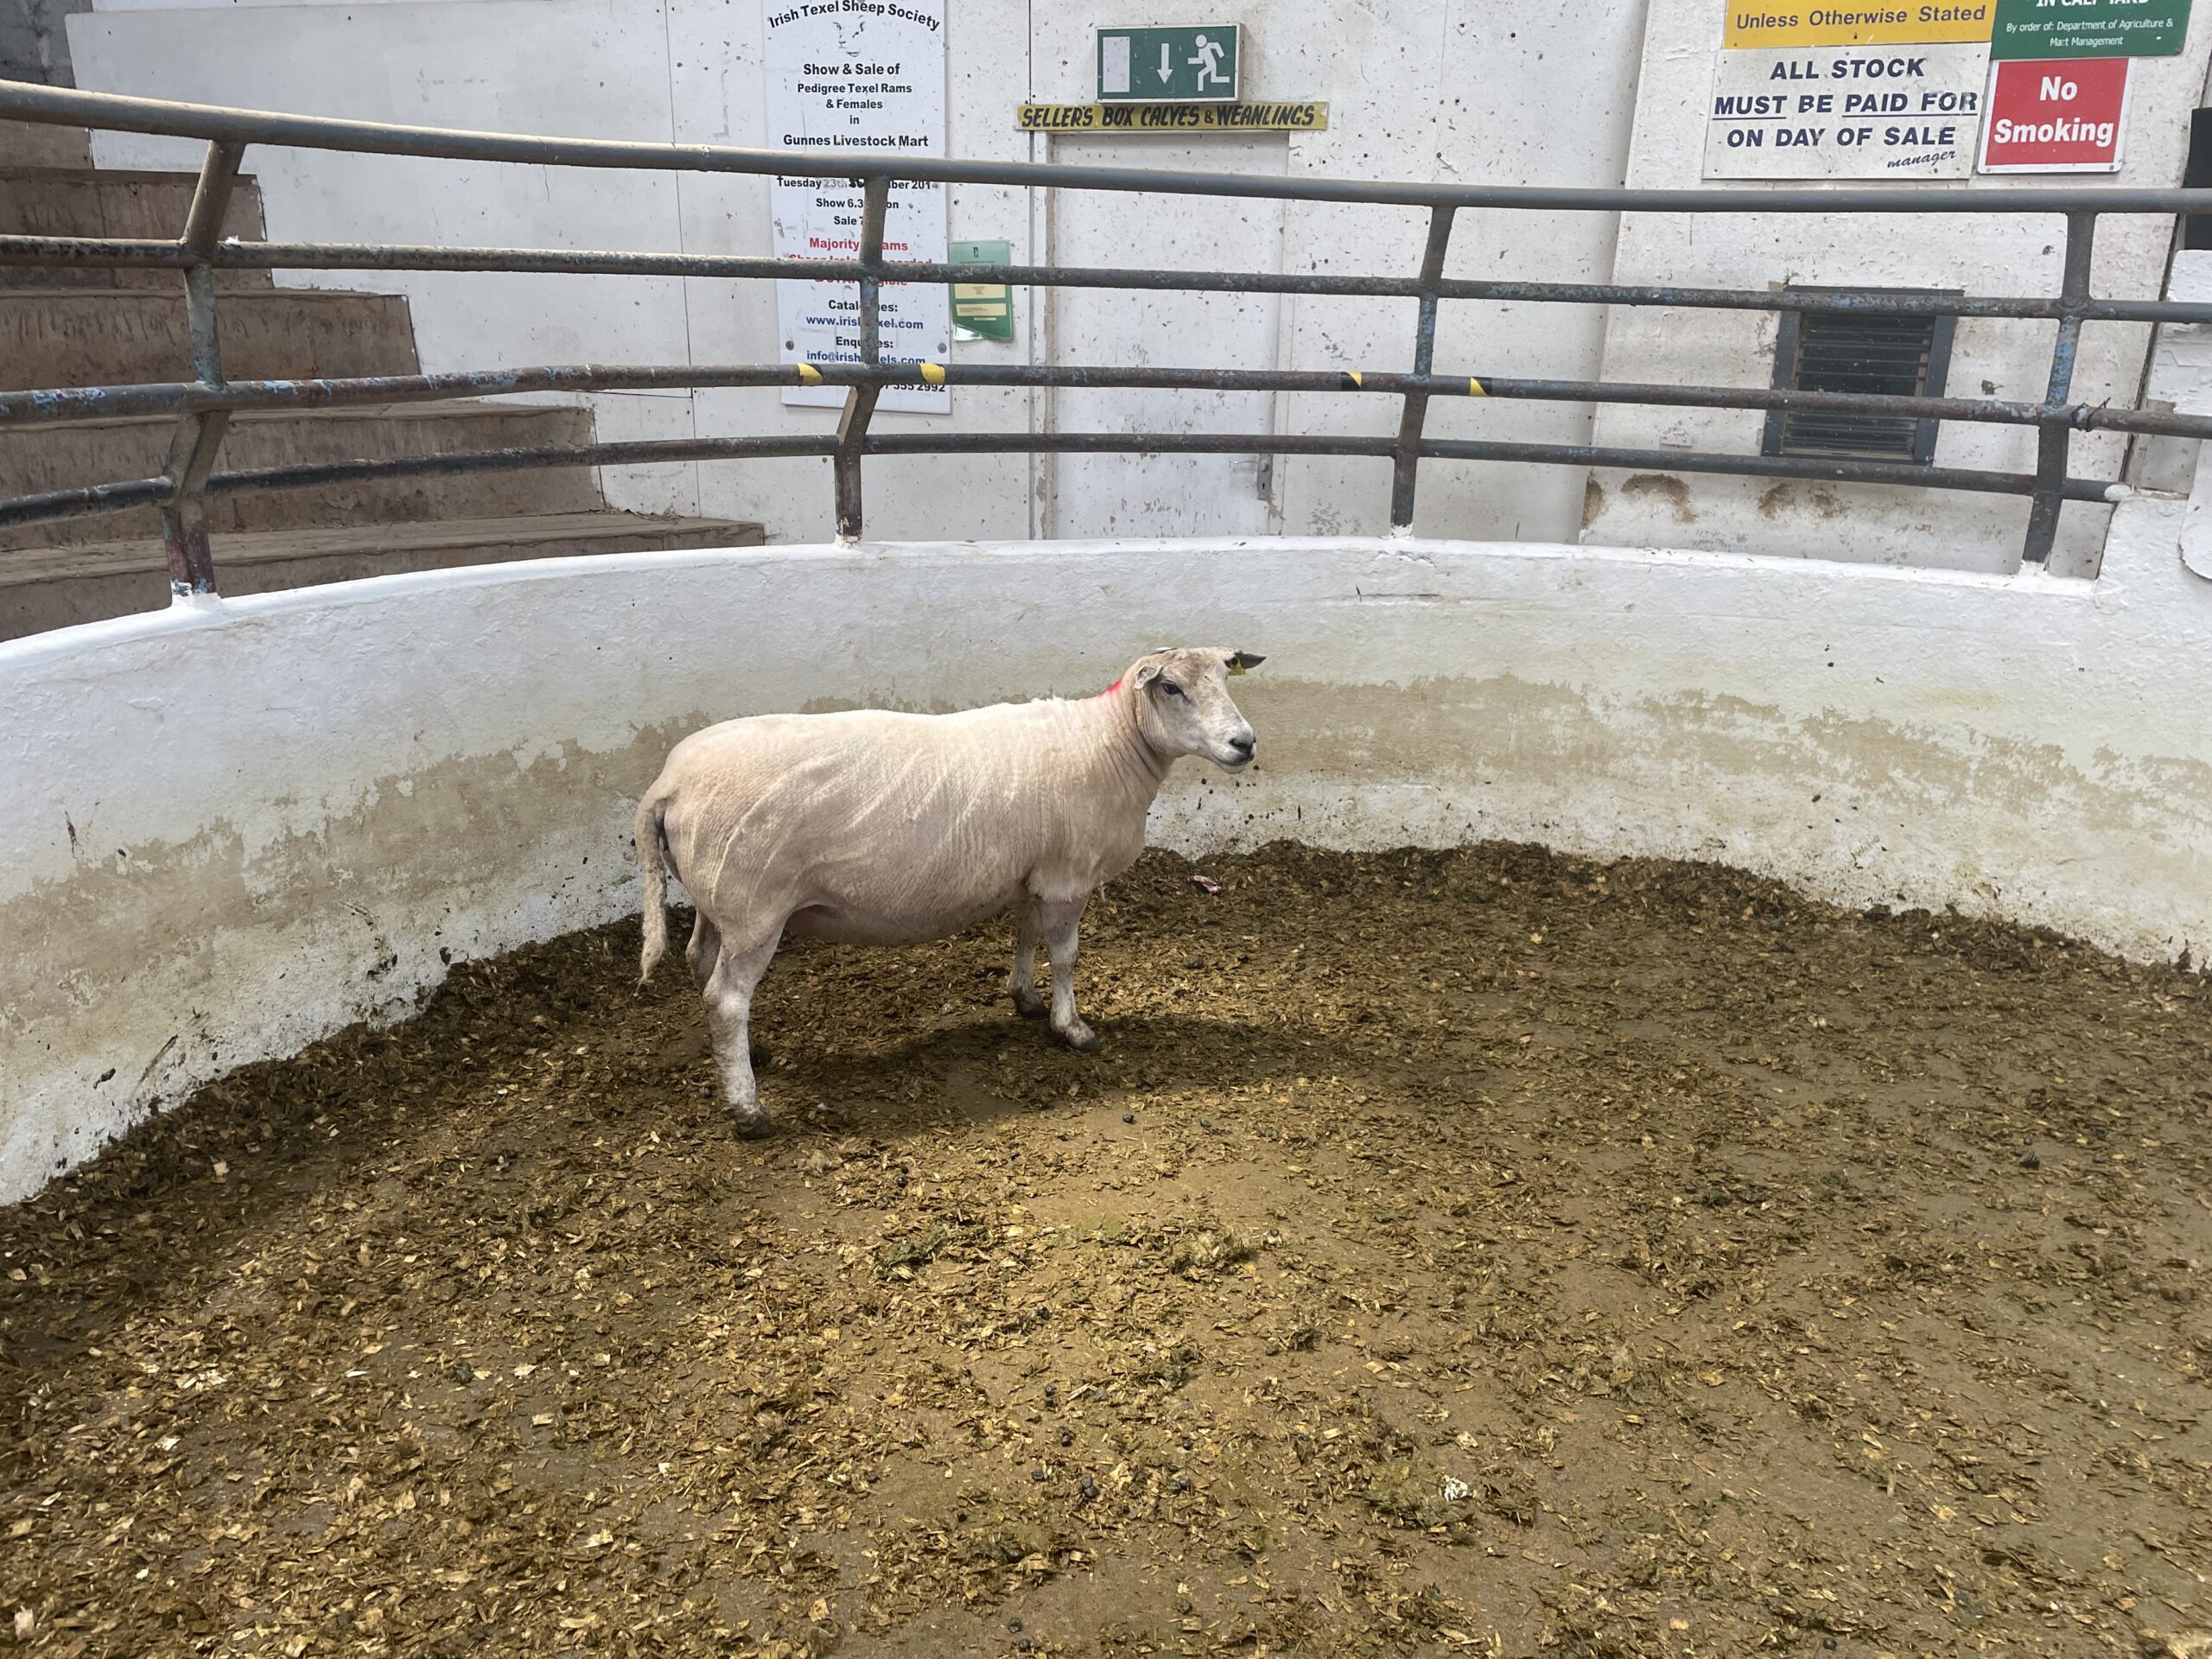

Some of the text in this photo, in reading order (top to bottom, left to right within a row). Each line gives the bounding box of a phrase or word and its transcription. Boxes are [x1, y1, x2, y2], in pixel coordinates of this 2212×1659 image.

[769, 0, 940, 31] Irish Texel Sheep Society
[1737, 4, 1986, 29] Unless Otherwise Stated
[2006, 22, 2018, 34] By
[2019, 22, 2041, 32] order
[2056, 21, 2106, 32] Department
[2108, 19, 2118, 29] of
[2119, 18, 2164, 31] Agriculture
[2166, 17, 2174, 28] &
[2071, 36, 2124, 48] Management
[804, 63, 900, 75] Show & Sale of
[1770, 58, 1927, 79] ALL STOCK
[798, 83, 912, 95] Pedigree Texel Rams
[2039, 76, 2078, 101] No
[826, 99, 883, 109] & Females
[1714, 92, 1978, 115] MUST BE PAID FOR
[849, 115, 860, 124] in
[1021, 105, 1315, 127] SELLER'S BOX CALVES & WEANLINGS
[783, 134, 928, 147] Gunnes Livestock Mart
[1727, 126, 1956, 147] ON DAY OF SALE
[1994, 118, 2114, 148] Smoking
[1887, 150, 1956, 170] manager
[778, 177, 822, 189] Tuesday
[816, 198, 845, 207] Show
[834, 216, 857, 225] Sale
[809, 238, 908, 251] Majority ams
